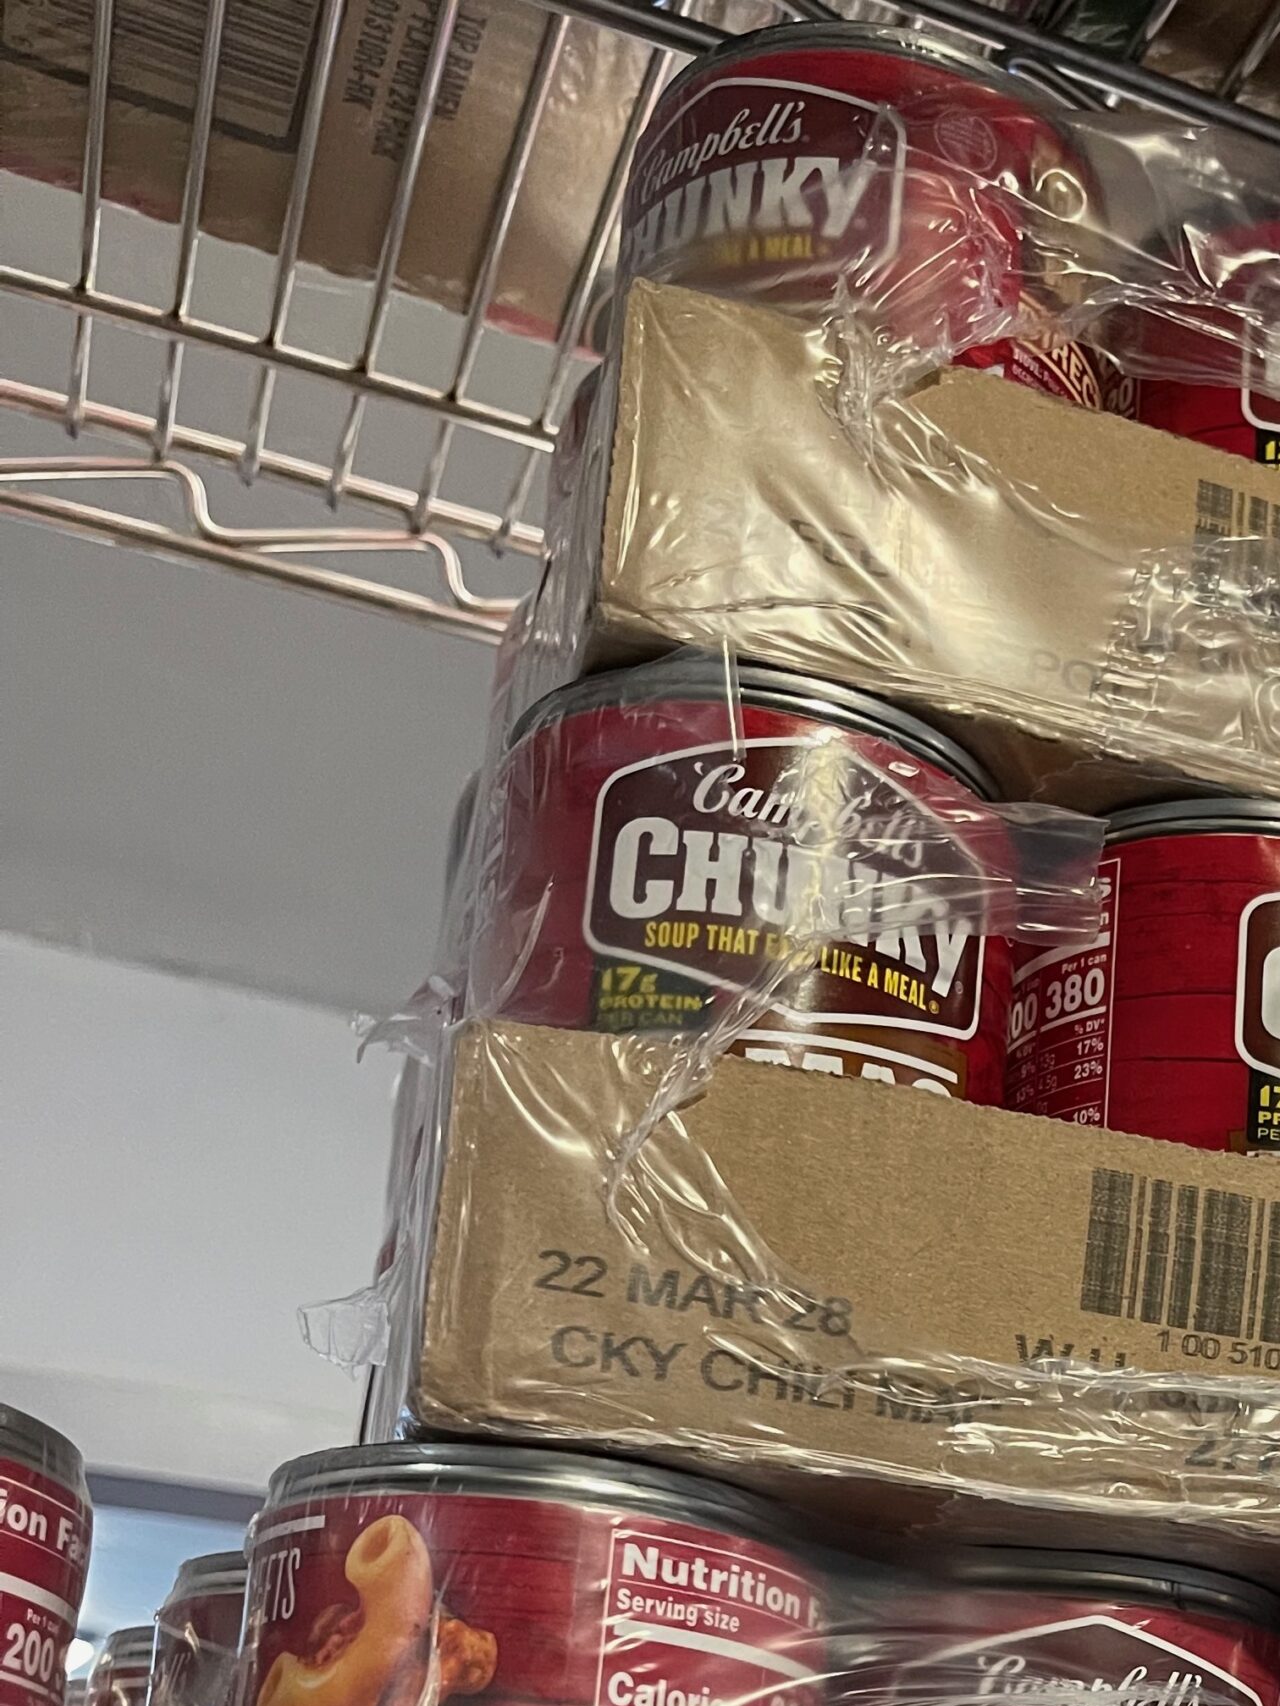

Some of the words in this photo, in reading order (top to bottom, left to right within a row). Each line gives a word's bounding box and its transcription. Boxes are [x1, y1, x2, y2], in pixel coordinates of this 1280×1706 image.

[632, 156, 878, 259] HUNKY
[645, 921, 699, 950] SOUP
[706, 924, 756, 955] THAT
[821, 947, 863, 983] LIKE
[884, 967, 927, 1011] MEAL
[1045, 968, 1106, 1020] 380
[534, 1249, 608, 1298] 22
[626, 1265, 763, 1323] MAR
[550, 1324, 687, 1382] CKY
[616, 1588, 698, 1627] Serving
[704, 1607, 740, 1633] size
[622, 1543, 801, 1620] Nutrition
[3, 1622, 55, 1681] 200
